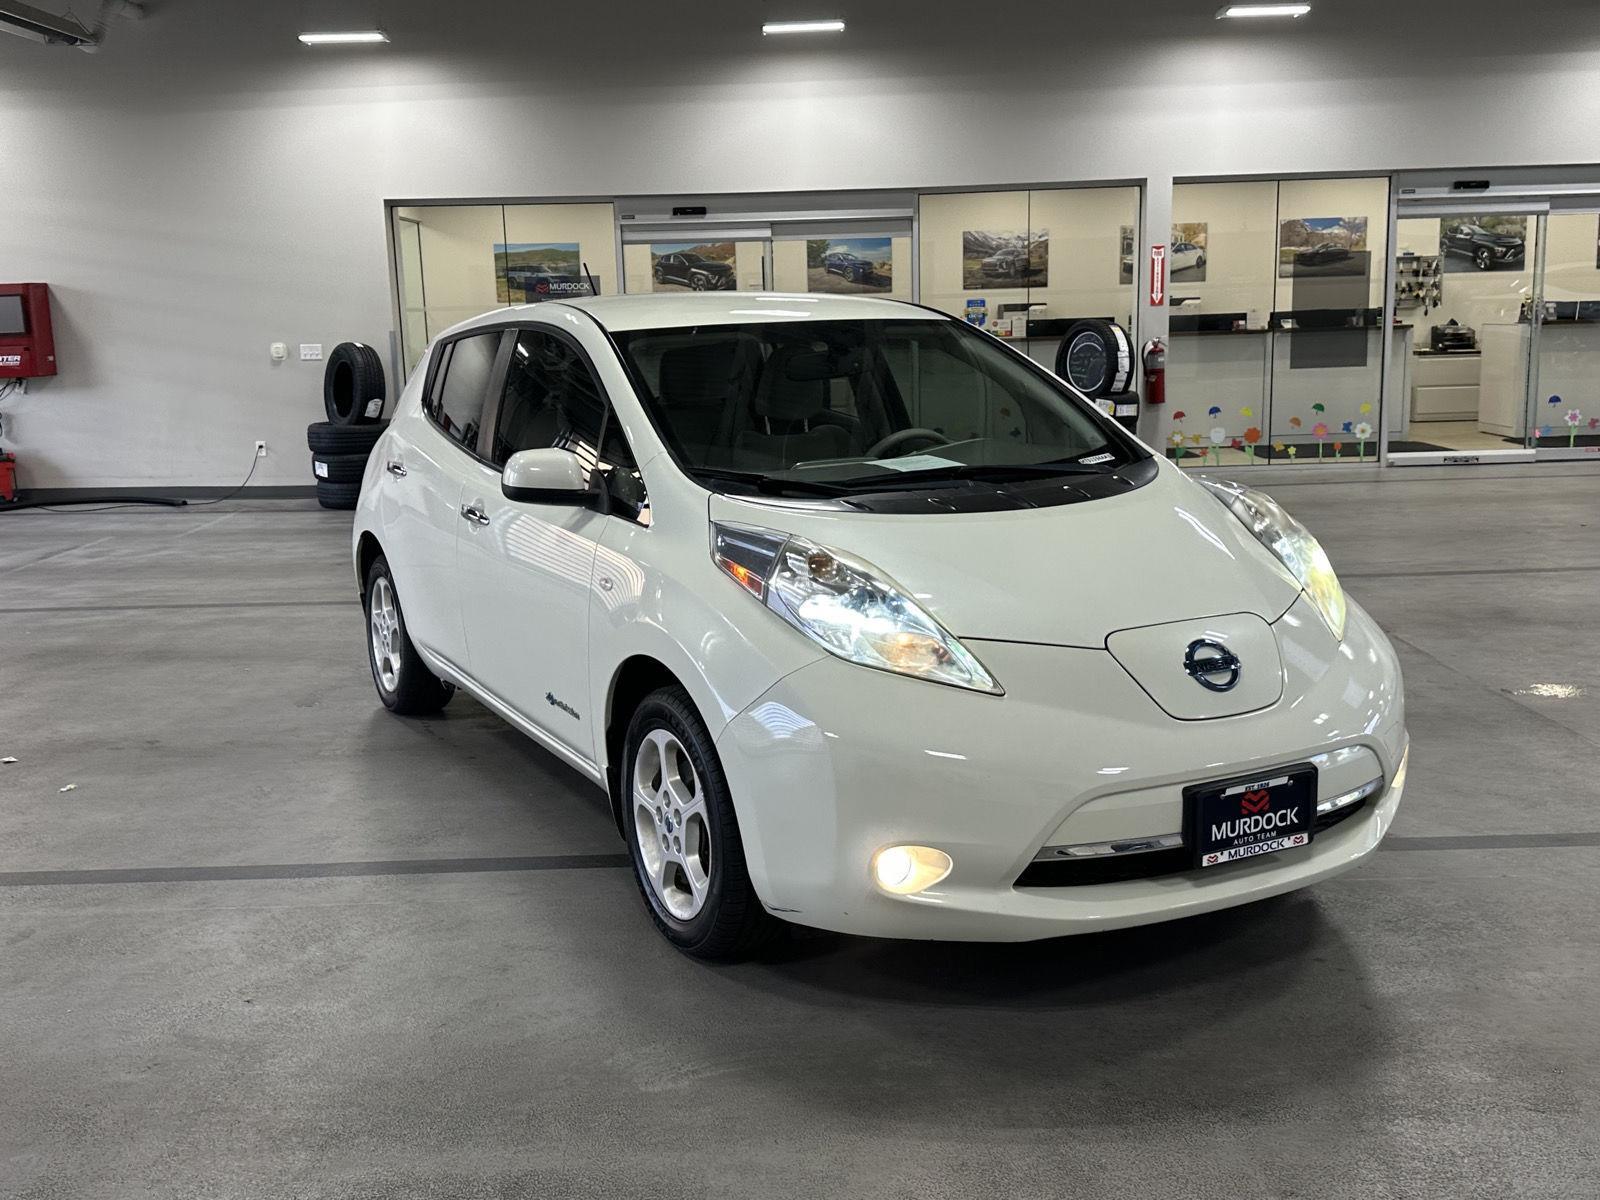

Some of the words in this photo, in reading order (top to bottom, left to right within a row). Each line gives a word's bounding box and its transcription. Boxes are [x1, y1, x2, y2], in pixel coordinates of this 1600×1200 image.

[549, 282, 590, 290] MURDOCK
[1211, 806, 1299, 842] MURDOCK
[1233, 835, 1254, 846] AUTO
[1257, 831, 1277, 840] TEAM
[1228, 838, 1285, 860] MURDOCK
